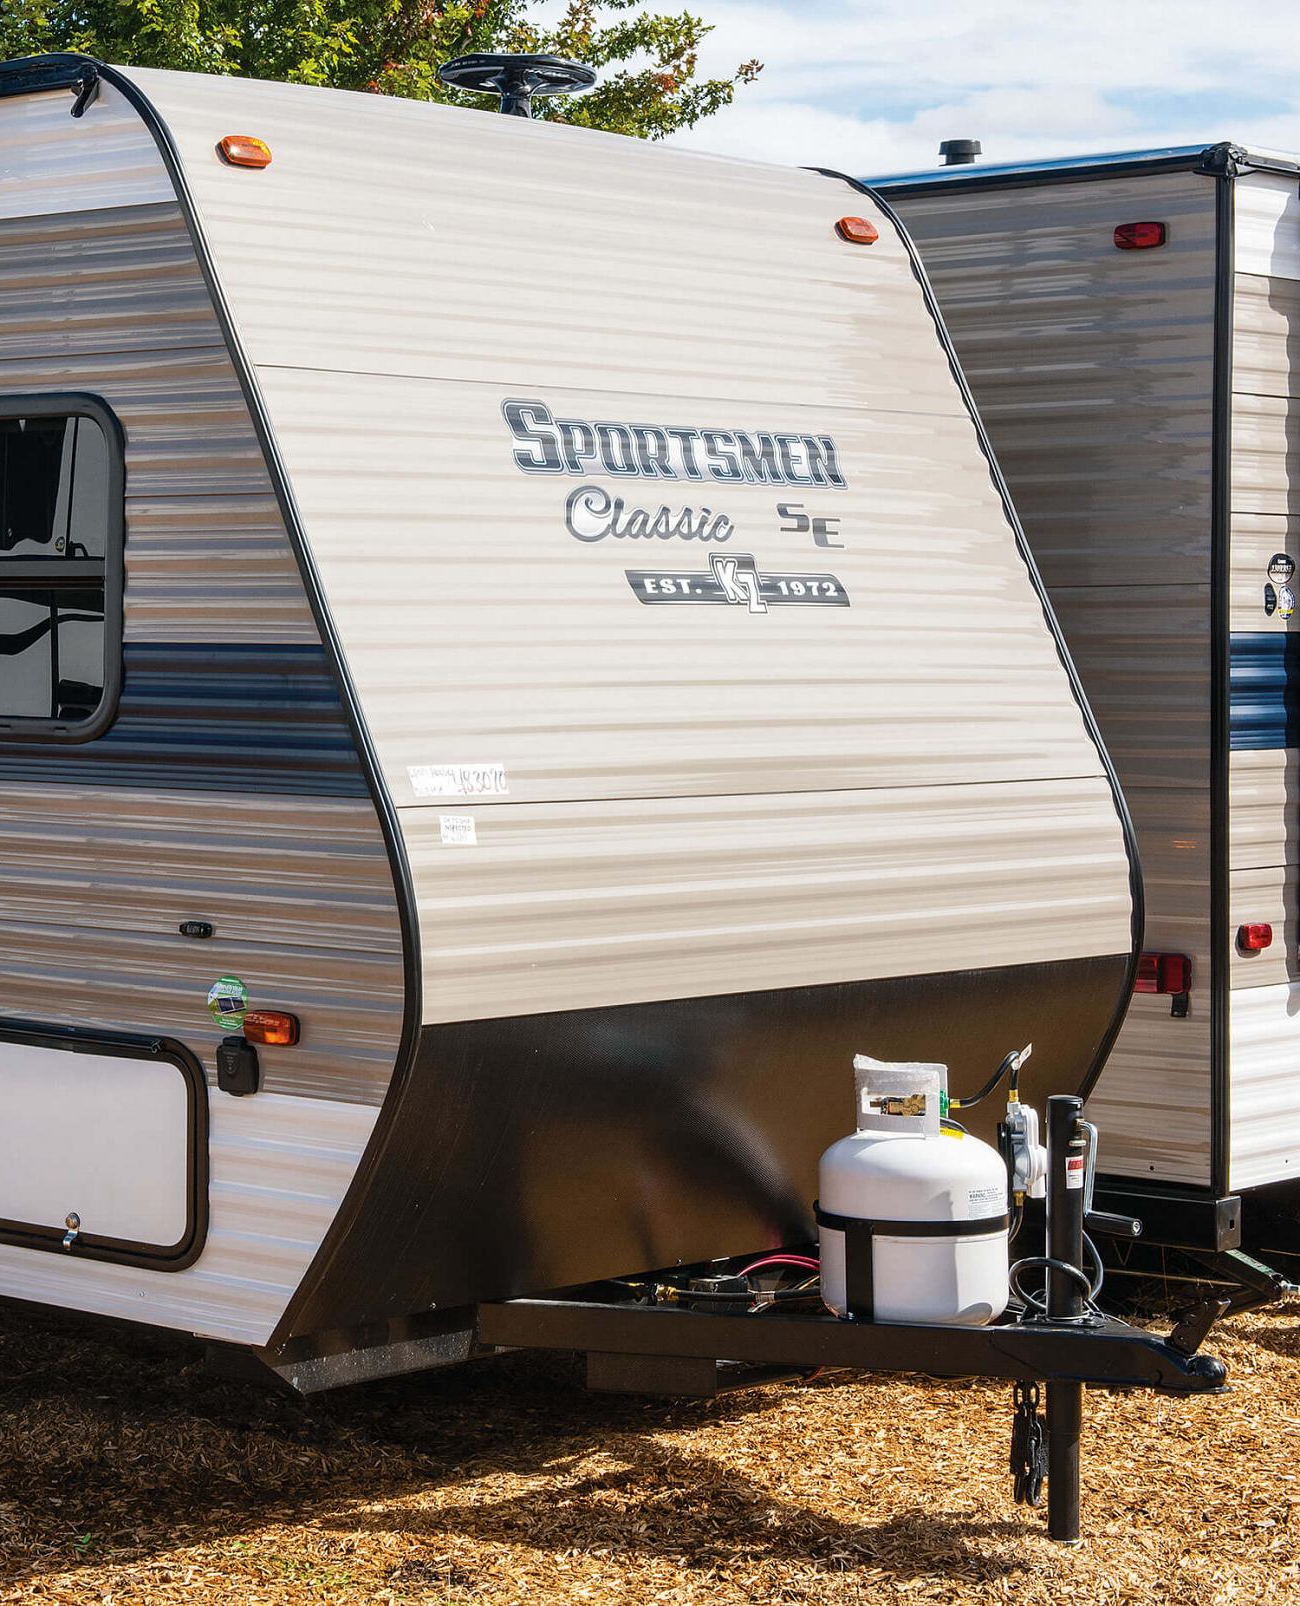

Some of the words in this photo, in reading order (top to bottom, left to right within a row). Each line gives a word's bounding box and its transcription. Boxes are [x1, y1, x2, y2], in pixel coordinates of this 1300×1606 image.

[501, 397, 849, 490] SPORTSMEN
[564, 485, 735, 543] Classic
[776, 503, 845, 549] SE
[645, 578, 702, 595] EST.
[712, 557, 768, 614] KZ
[777, 580, 839, 598] 1972
